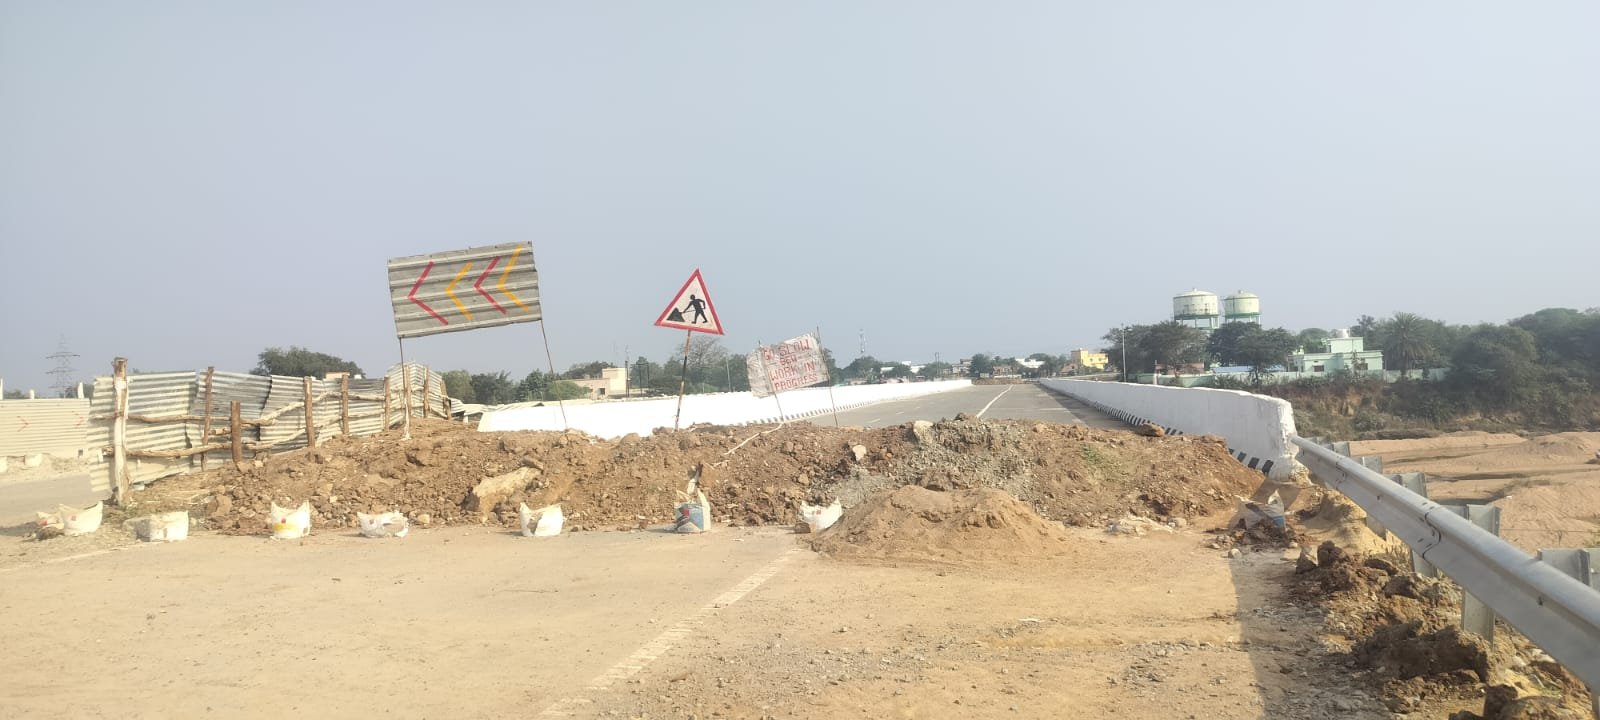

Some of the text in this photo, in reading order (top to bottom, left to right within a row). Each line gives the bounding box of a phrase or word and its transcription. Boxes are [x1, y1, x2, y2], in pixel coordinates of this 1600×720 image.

[779, 339, 810, 357] SLOW
[769, 361, 817, 381] WORK IN
[774, 373, 818, 392] PROGRESS
